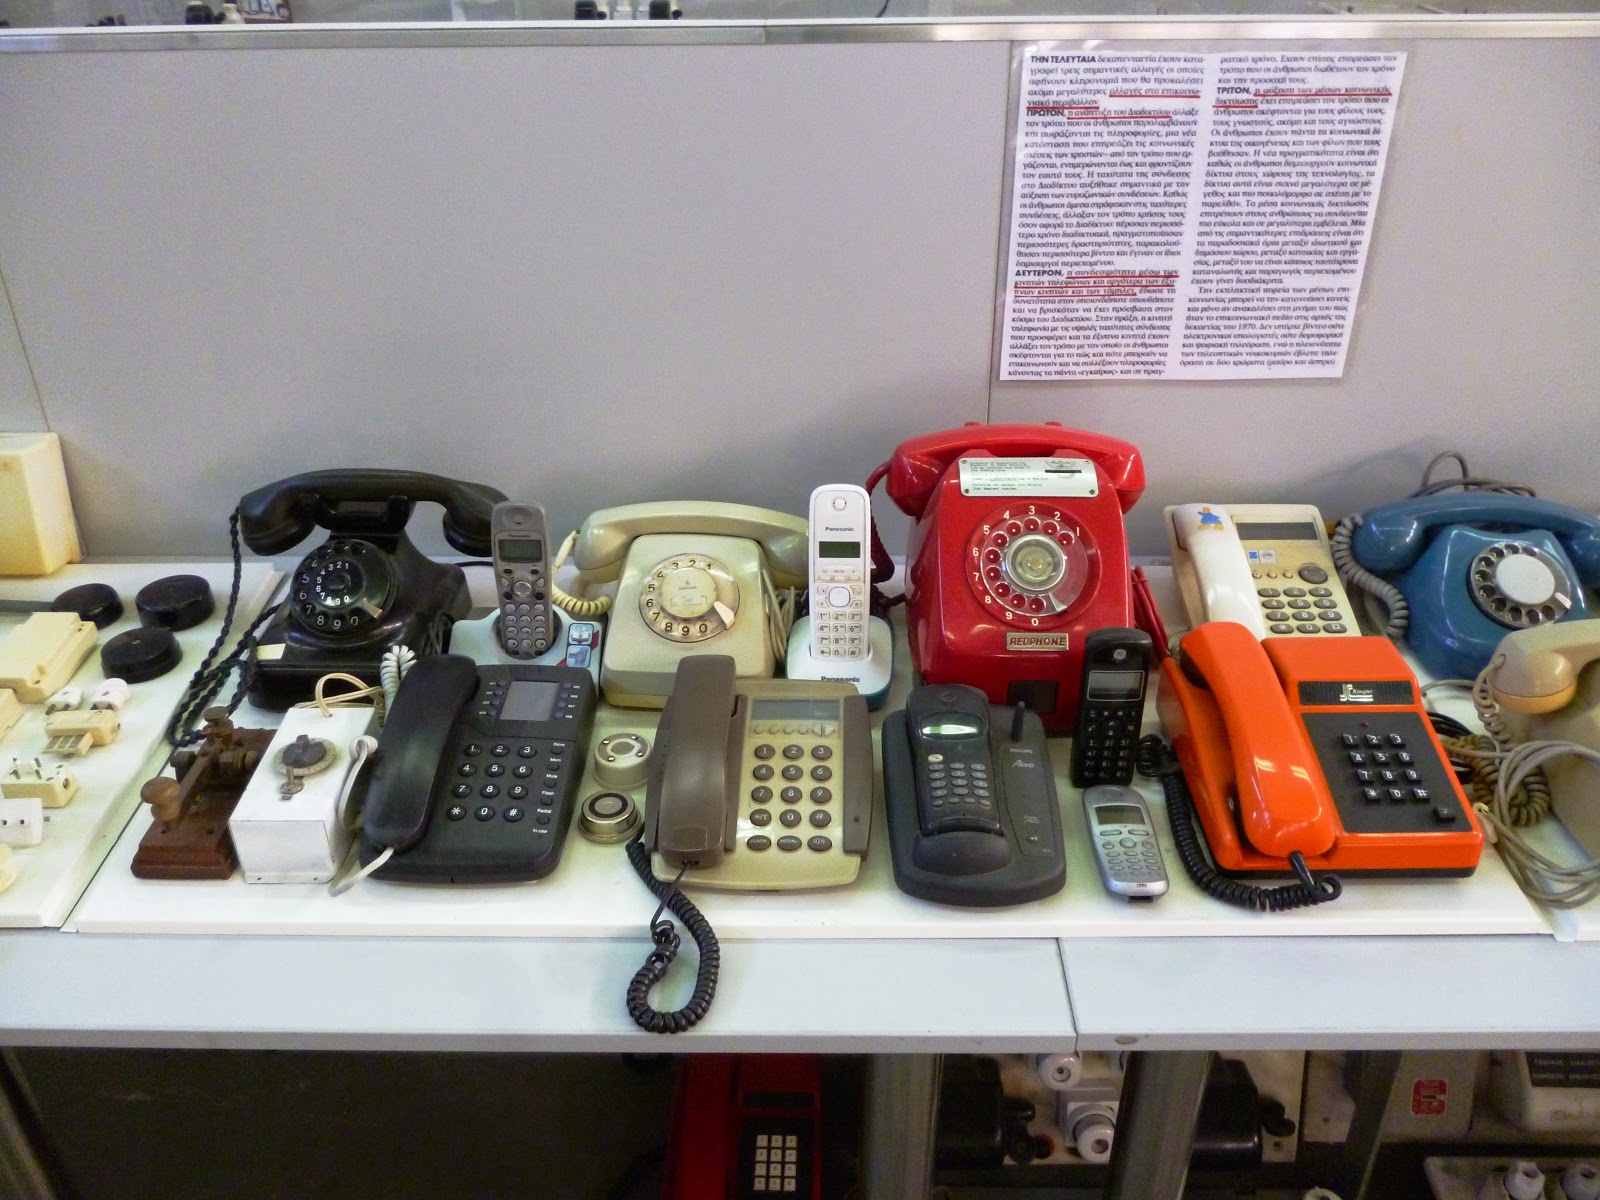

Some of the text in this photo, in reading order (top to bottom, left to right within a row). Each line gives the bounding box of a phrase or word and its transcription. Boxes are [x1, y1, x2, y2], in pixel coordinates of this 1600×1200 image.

[1216, 86, 1251, 95] ΤΡΙΤΟΝ,
[1026, 109, 1066, 118] ΠΡΩΤΟΝ,
[1015, 269, 1064, 277] ΔΕΥΤΕΡΟΝ,
[973, 506, 1079, 557] 6 5 4 3 2 1
[648, 584, 655, 592] 5
[299, 574, 358, 630] 5 6 7 8 9 0
[646, 599, 654, 607] 6
[973, 572, 1039, 626] 7 8 9 0
[653, 613, 707, 636] 7 8 9 0
[1010, 635, 1066, 646] REDPHONE
[486, 785, 493, 793] 8
[481, 807, 488, 815] 0
